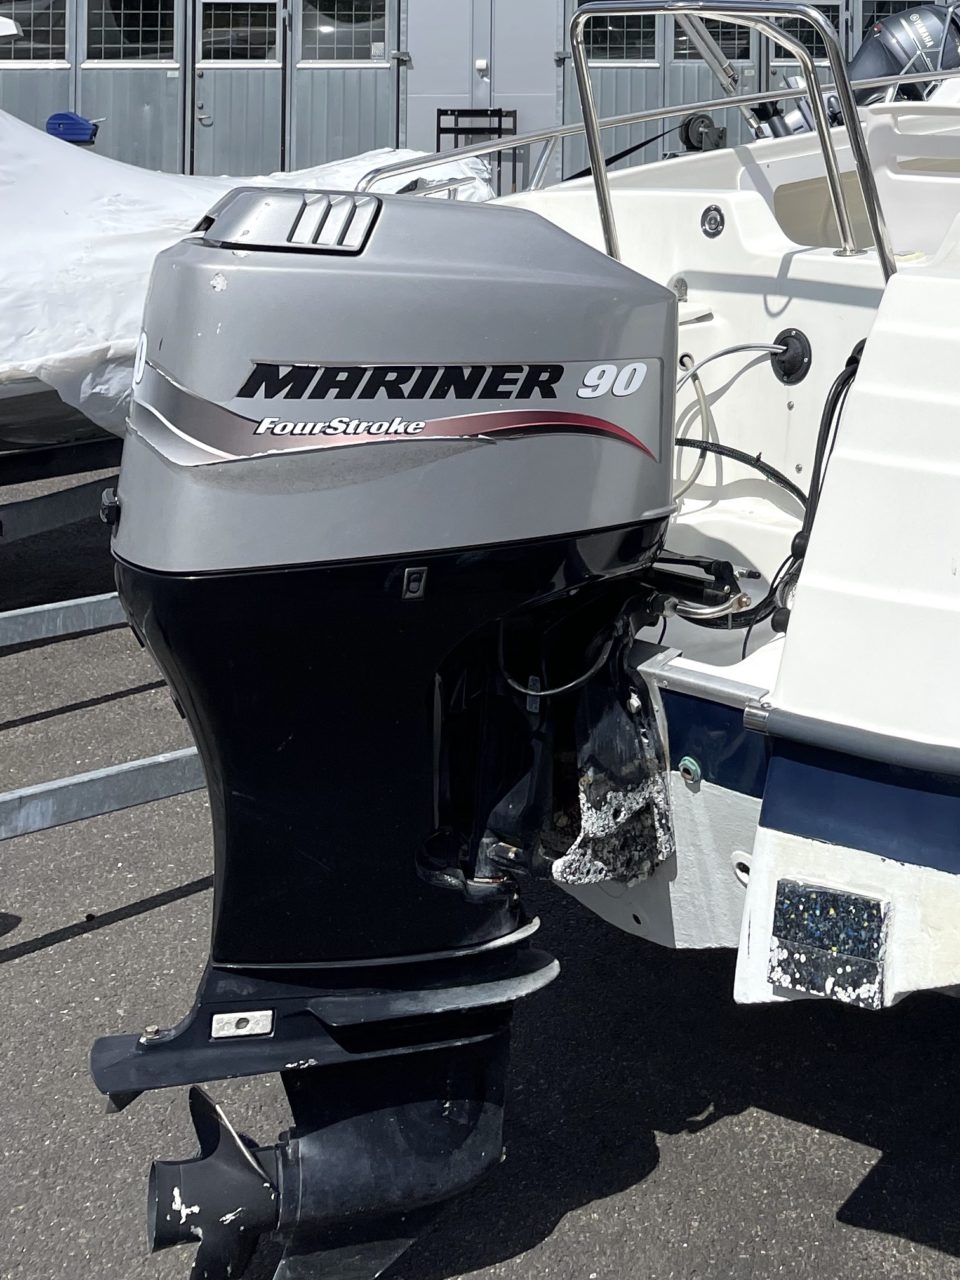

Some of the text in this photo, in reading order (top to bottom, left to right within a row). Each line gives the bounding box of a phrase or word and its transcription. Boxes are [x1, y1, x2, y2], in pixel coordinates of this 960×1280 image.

[914, 19, 934, 48] YAMAHA
[235, 362, 648, 401] MARINER 90
[252, 416, 426, 436] FourStroke
